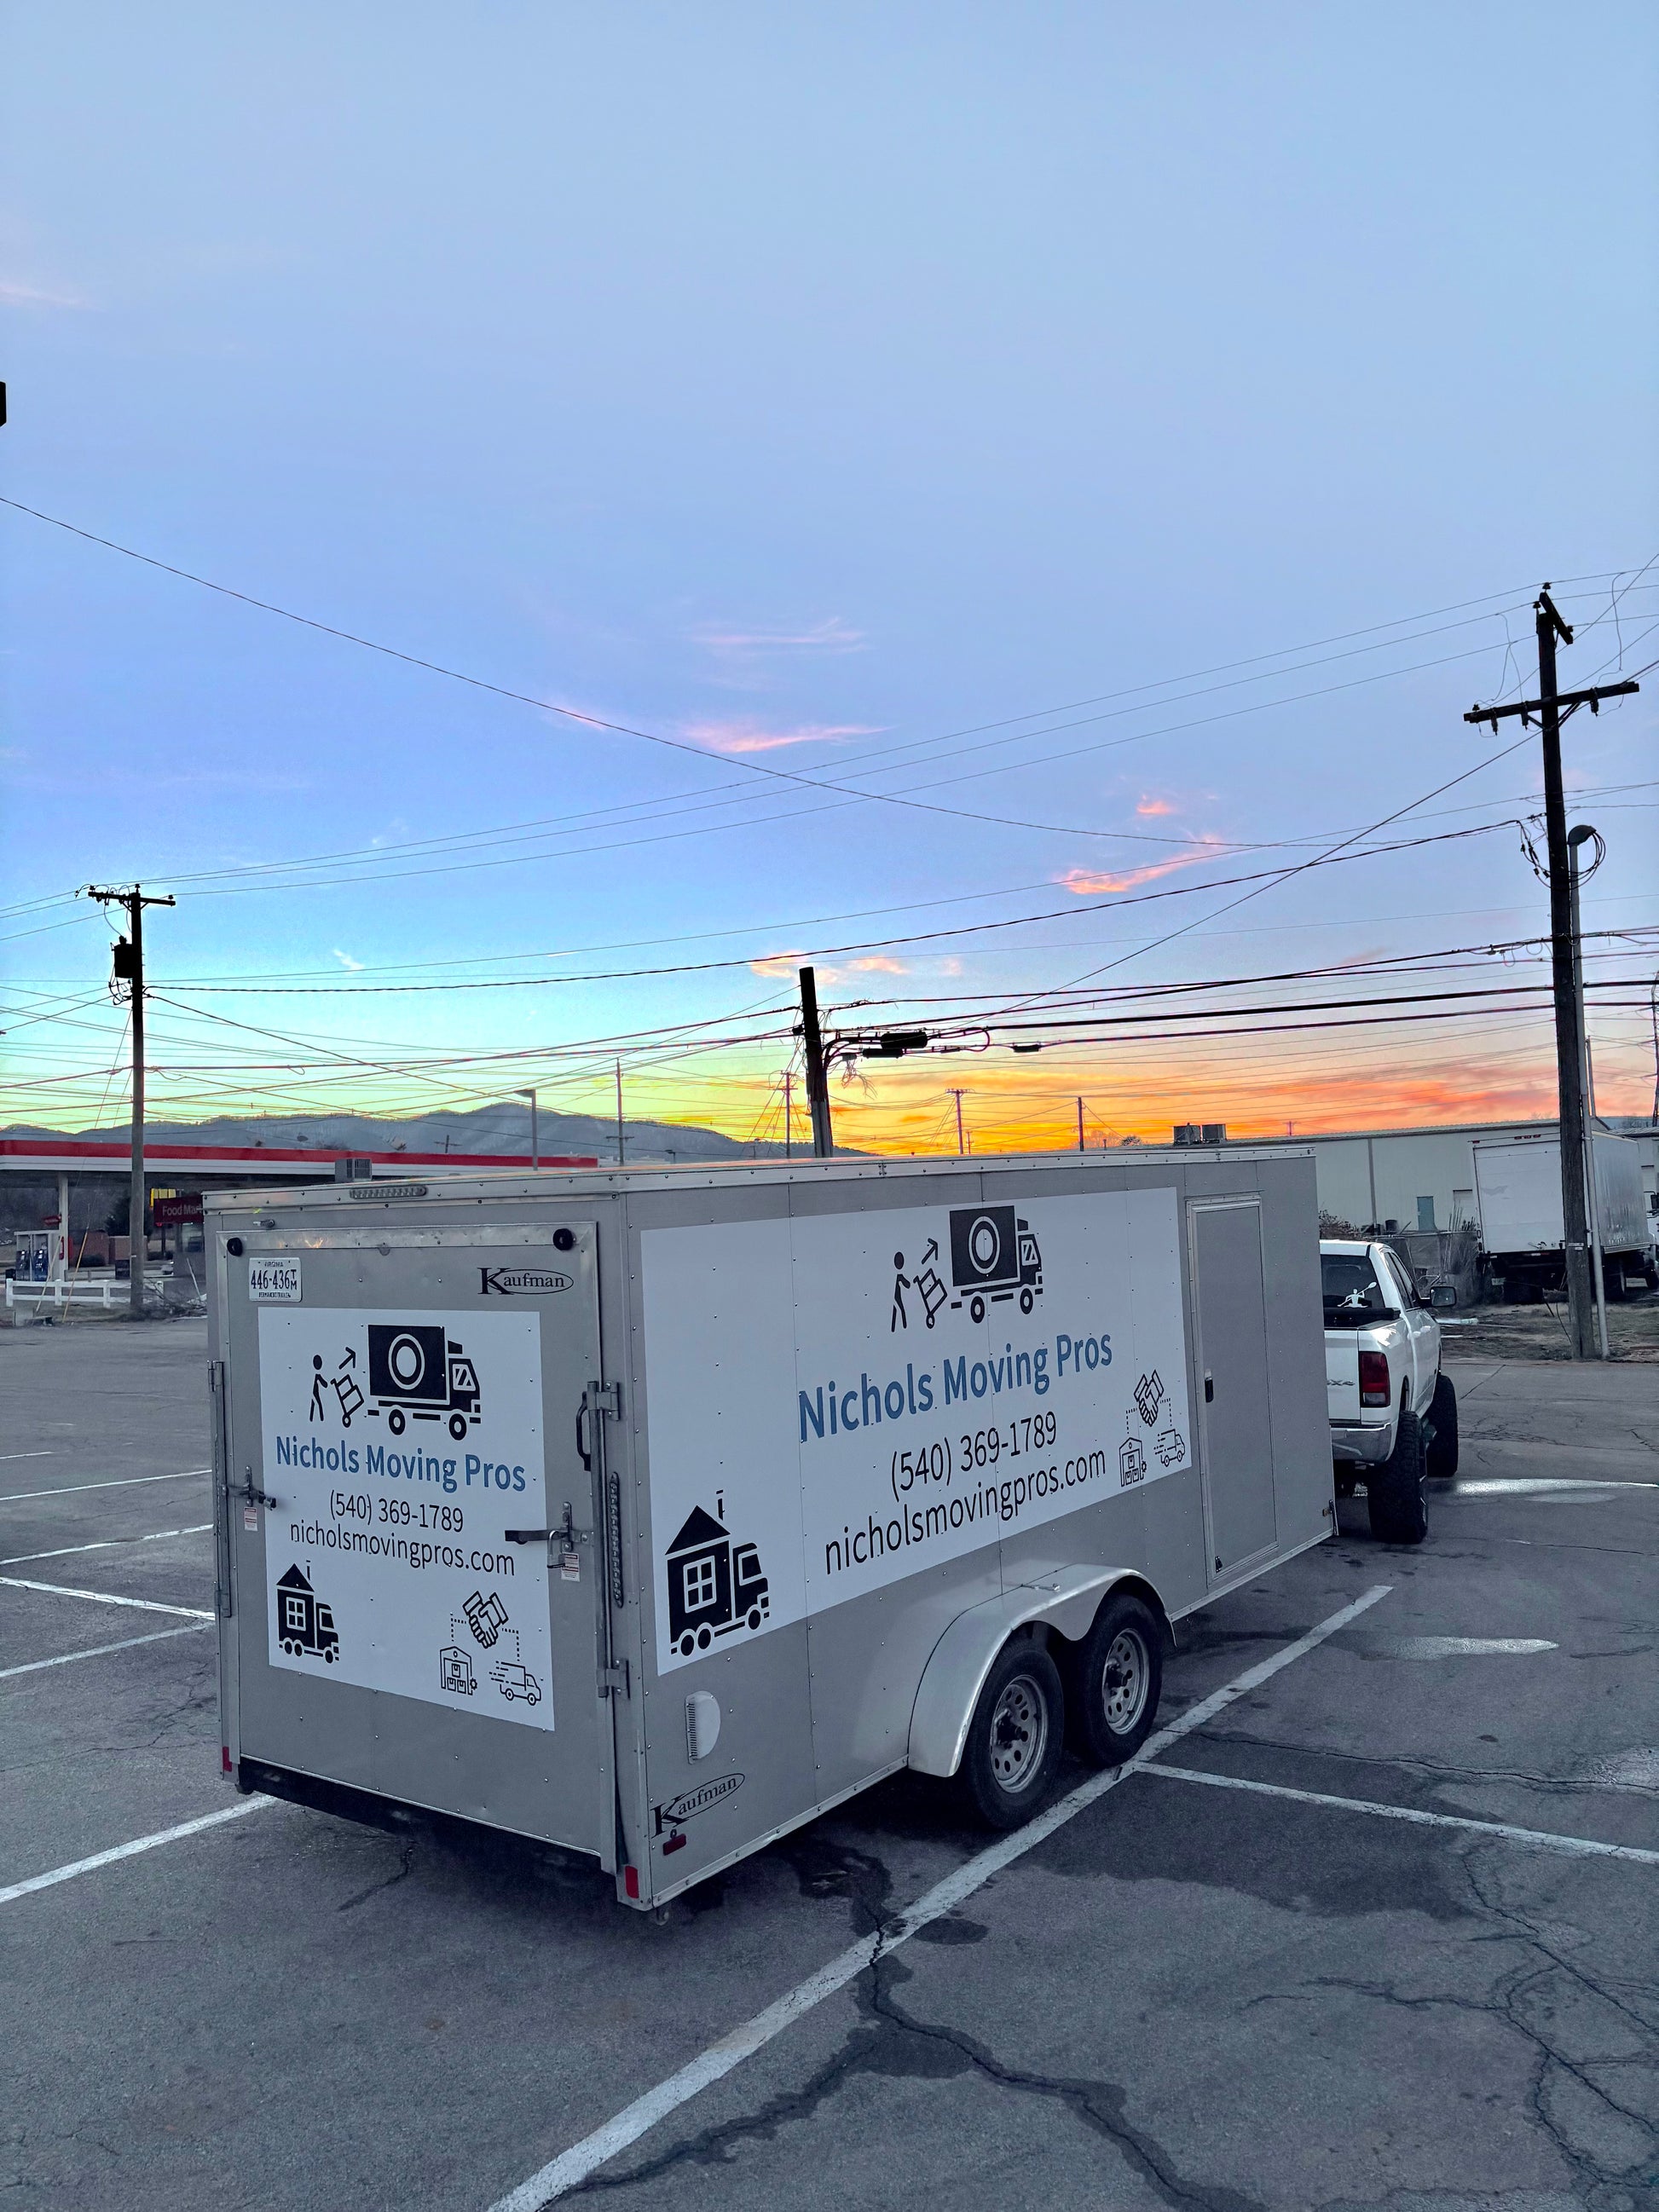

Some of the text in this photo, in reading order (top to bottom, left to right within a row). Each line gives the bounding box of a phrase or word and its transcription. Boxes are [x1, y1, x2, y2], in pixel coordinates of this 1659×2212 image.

[162, 1204, 182, 1216] Food
[477, 1267, 565, 1295] Kaufman
[798, 1333, 1113, 1442] Nichols Moving Pros
[276, 1435, 526, 1493] Nichols Moving Pros
[891, 1411, 1057, 1501] (540) 369-1789
[330, 1489, 465, 1533] (540) 369-1789
[824, 1448, 1106, 1574] nicholsmovingpros.com
[290, 1519, 515, 1576] nicholsmovingpros.com
[650, 1776, 738, 1839] Kaufman
